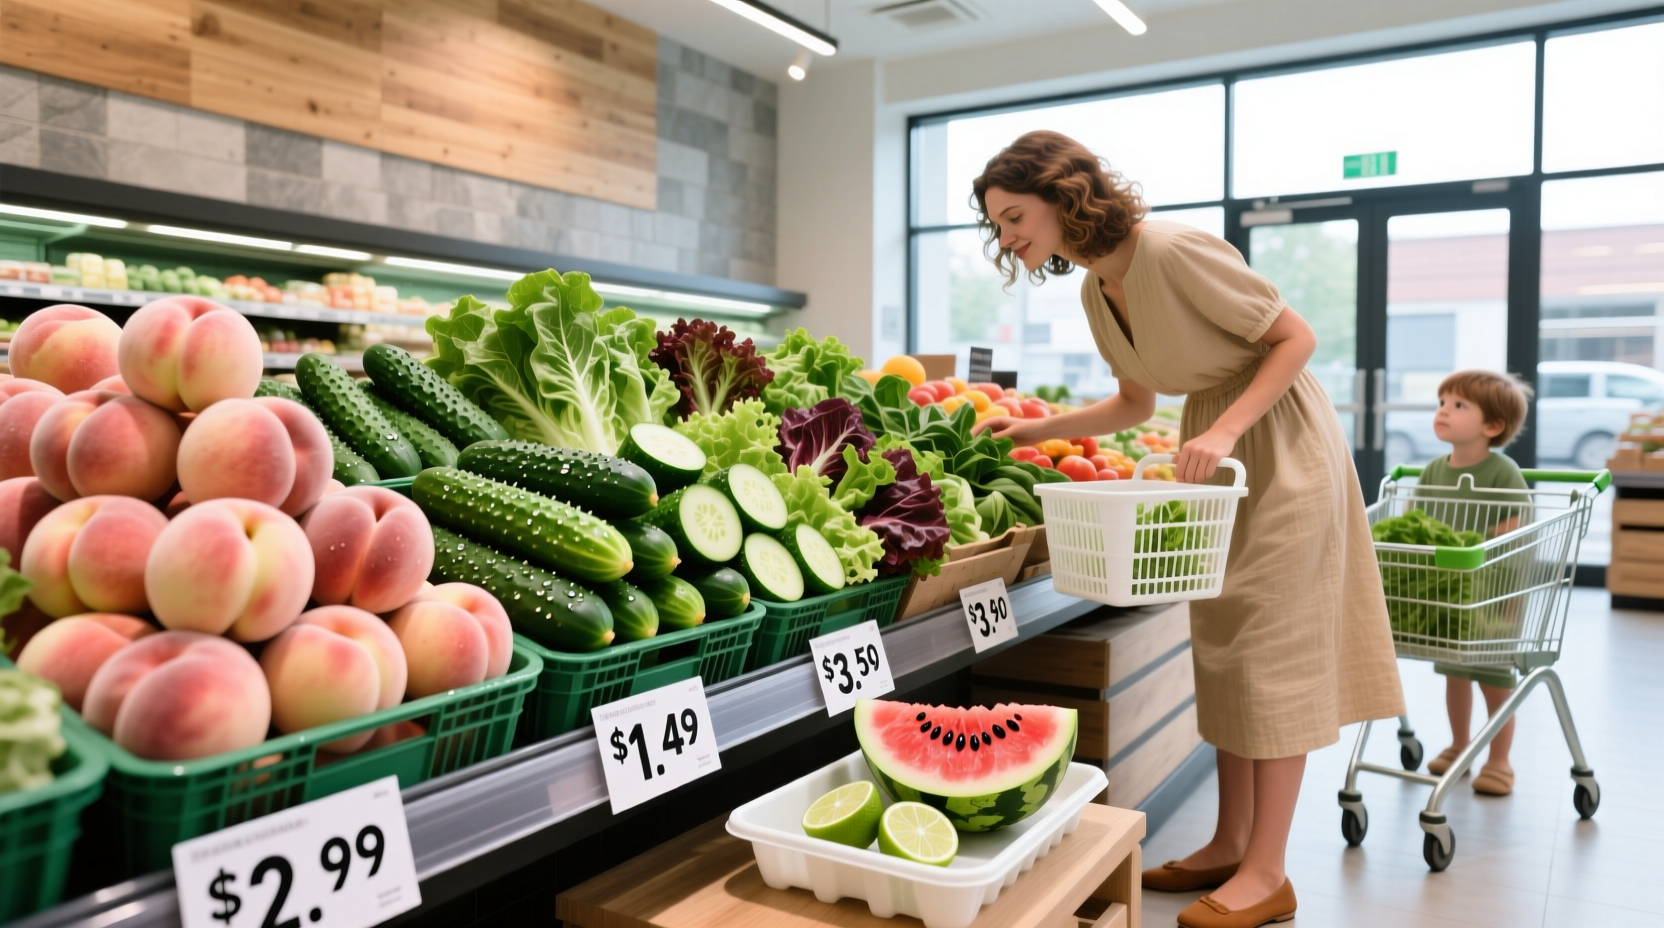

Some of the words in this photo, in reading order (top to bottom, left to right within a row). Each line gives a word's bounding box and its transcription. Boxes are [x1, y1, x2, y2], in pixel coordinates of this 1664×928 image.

[822, 643, 880, 694] $3.59
[610, 708, 698, 781] $1.49
[208, 824, 385, 928] $2.99
